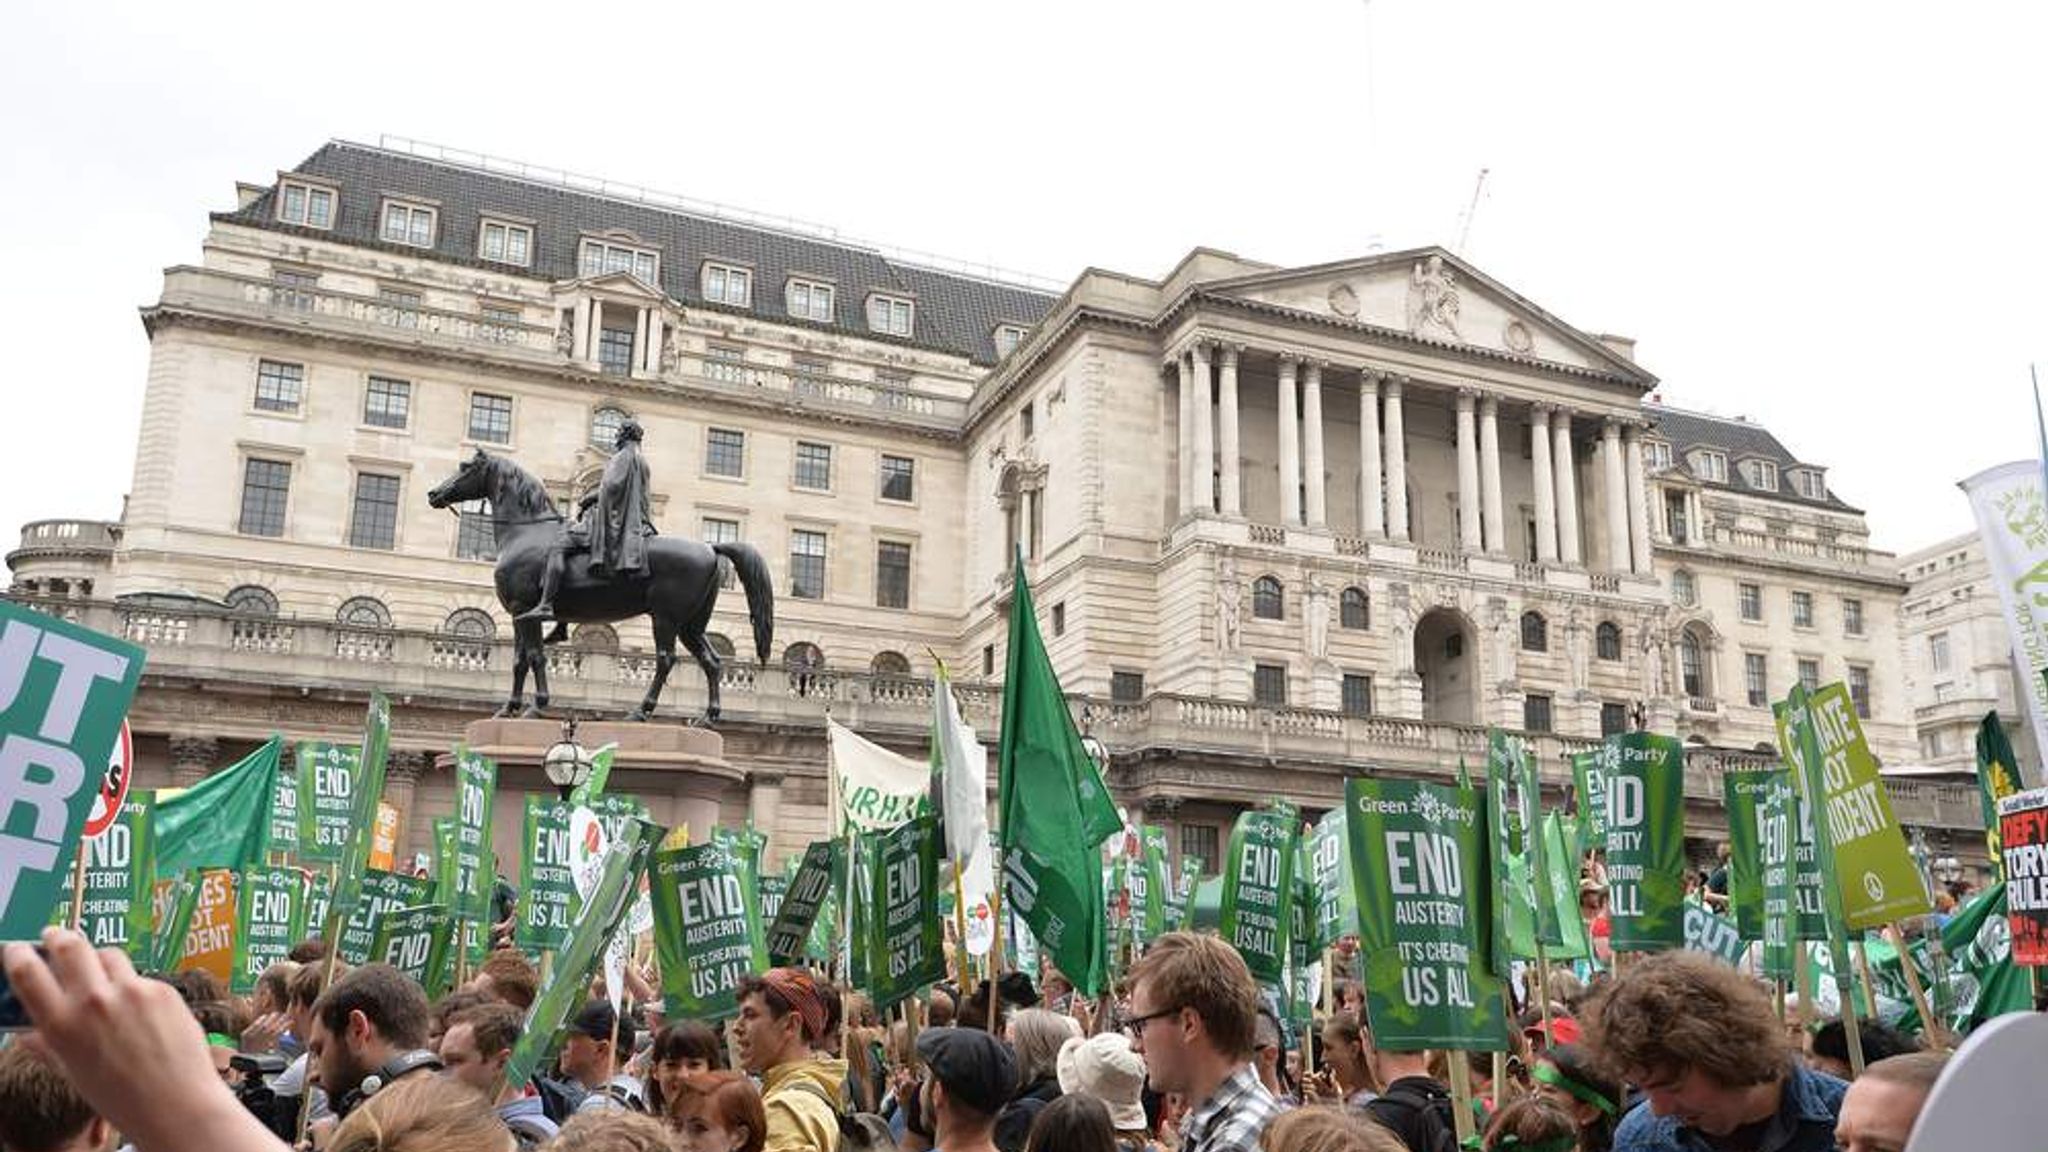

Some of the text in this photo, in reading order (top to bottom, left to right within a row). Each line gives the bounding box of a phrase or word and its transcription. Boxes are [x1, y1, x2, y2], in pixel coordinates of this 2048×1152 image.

[1624, 747, 1669, 766] Party
[315, 766, 351, 797] END
[121, 802, 147, 816] arty
[1358, 795, 1476, 828] Green Party
[1607, 775, 1645, 827] ND
[70, 822, 131, 868] ND
[315, 826, 331, 845] US
[2003, 811, 2048, 848] DEFY
[657, 860, 697, 875] Green
[886, 852, 921, 910] END
[1238, 843, 1281, 889] END
[1385, 831, 1463, 898] END
[198, 874, 227, 907] ES
[251, 890, 290, 923] END
[678, 873, 745, 927] END
[2007, 878, 2048, 911] RULE
[347, 893, 408, 931] EN
[527, 905, 569, 929] US ALL
[1395, 900, 1464, 928] AUSTERITY
[94, 917, 129, 944] ALL
[183, 923, 231, 957] DENT
[685, 917, 748, 945] AUSTERITY
[1234, 924, 1277, 958] US ALL
[1683, 908, 1741, 959] CUT
[246, 956, 264, 975] US
[385, 932, 432, 971] END
[888, 950, 907, 979] US
[1398, 940, 1424, 961] IT'S
[691, 967, 717, 999] US
[1402, 966, 1476, 1009] US ALL
